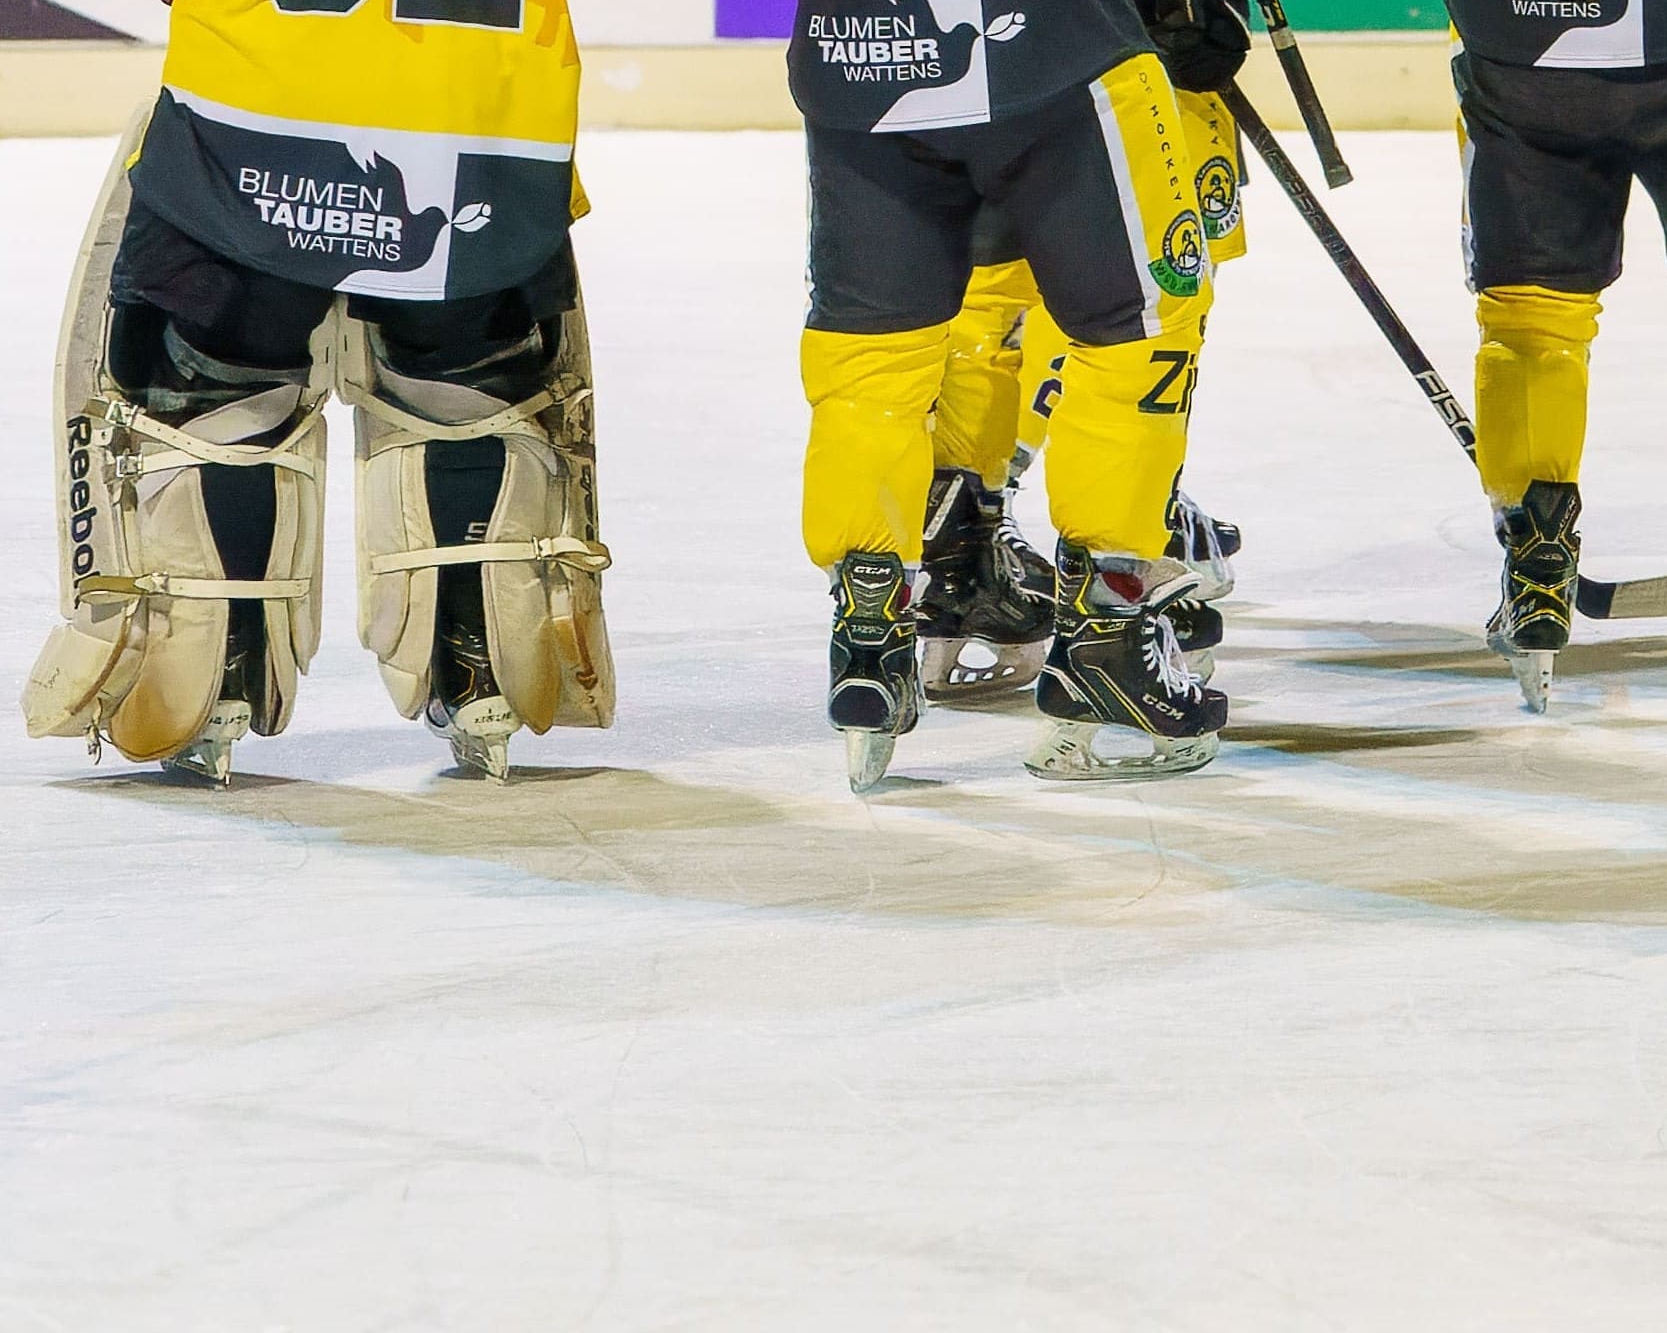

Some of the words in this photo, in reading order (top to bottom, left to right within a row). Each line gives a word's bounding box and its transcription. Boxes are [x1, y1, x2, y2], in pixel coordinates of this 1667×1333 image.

[807, 12, 917, 42] BLUMEN
[817, 37, 940, 64] TAUBER
[842, 61, 944, 84] WATTENS
[1149, 103, 1184, 203] HOCKEY
[238, 166, 384, 213] BLUMEN
[252, 196, 404, 243] TAUBER
[286, 230, 402, 263] WATTENS
[1142, 692, 1187, 721] CCM
